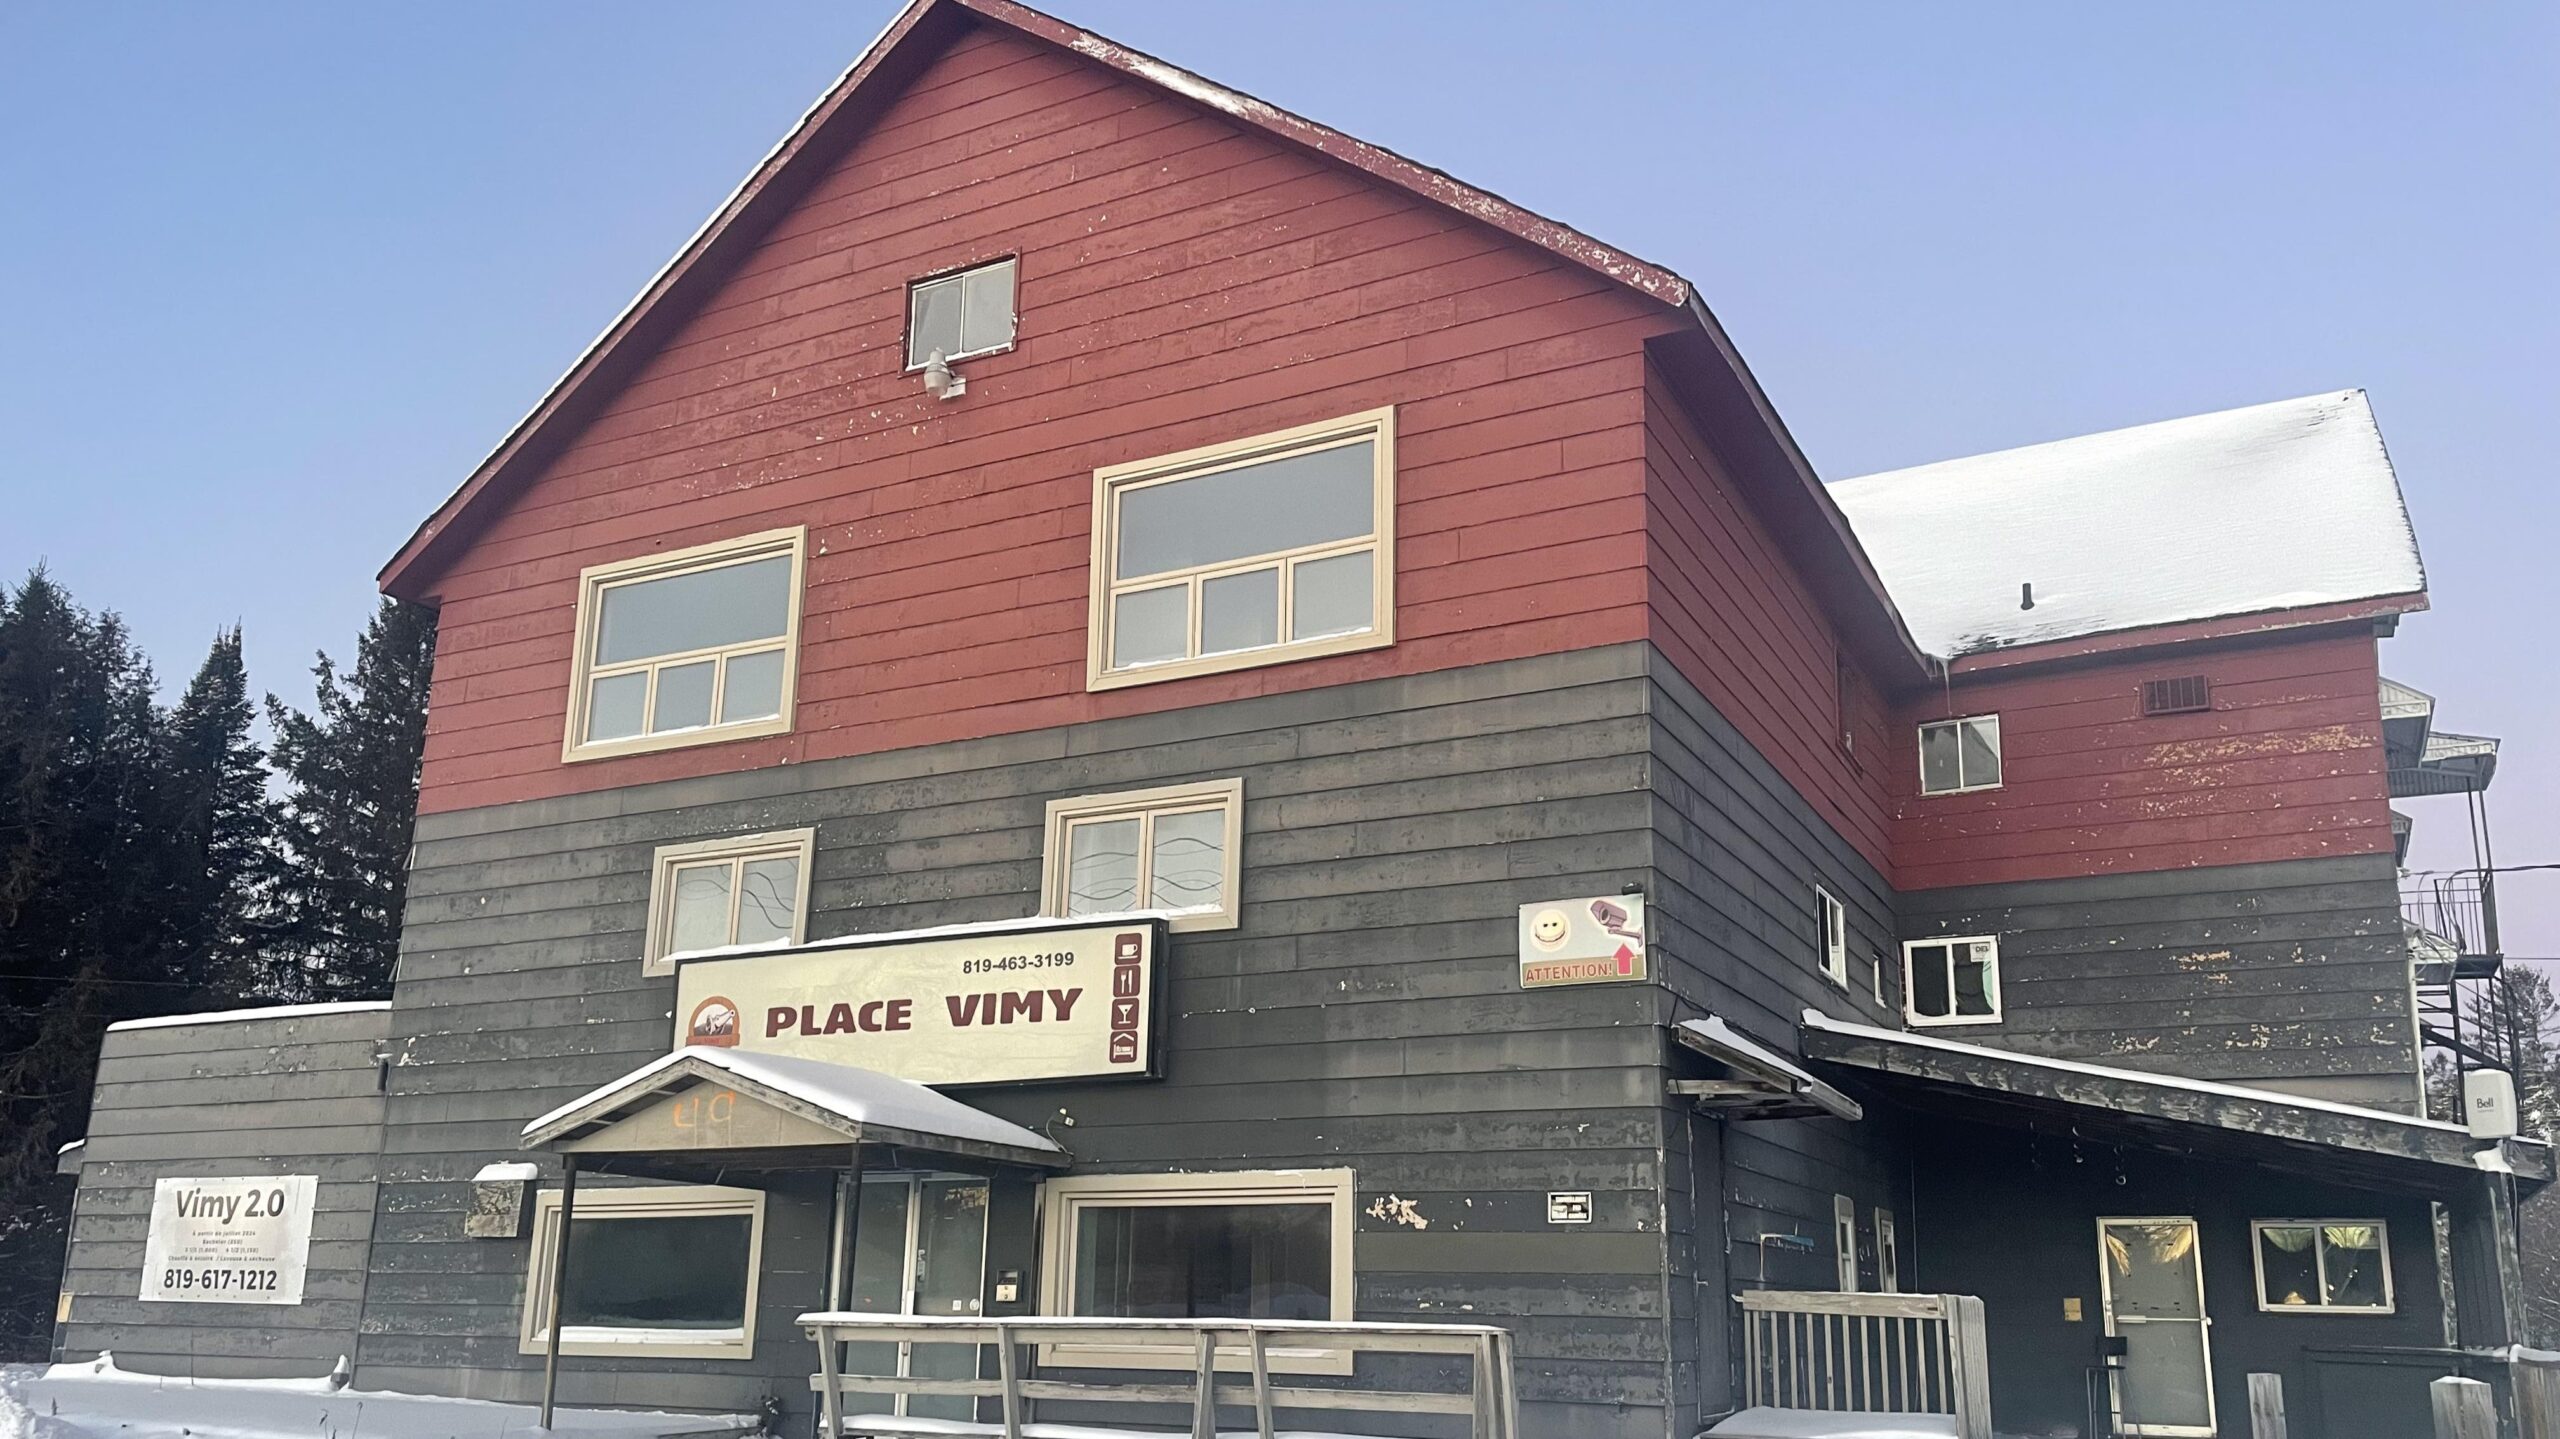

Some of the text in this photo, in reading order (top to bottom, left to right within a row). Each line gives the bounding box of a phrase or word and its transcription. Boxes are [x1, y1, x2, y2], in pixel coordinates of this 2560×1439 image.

[963, 952, 1075, 975] 819-463-3199
[1526, 963, 1613, 982] ATTENTION!
[765, 987, 1084, 1038] PLACE VIMY
[2476, 1097, 2494, 1108] Bell
[176, 1187, 285, 1225] Vimy 2.0
[164, 1268, 277, 1291] 819-617-1212
